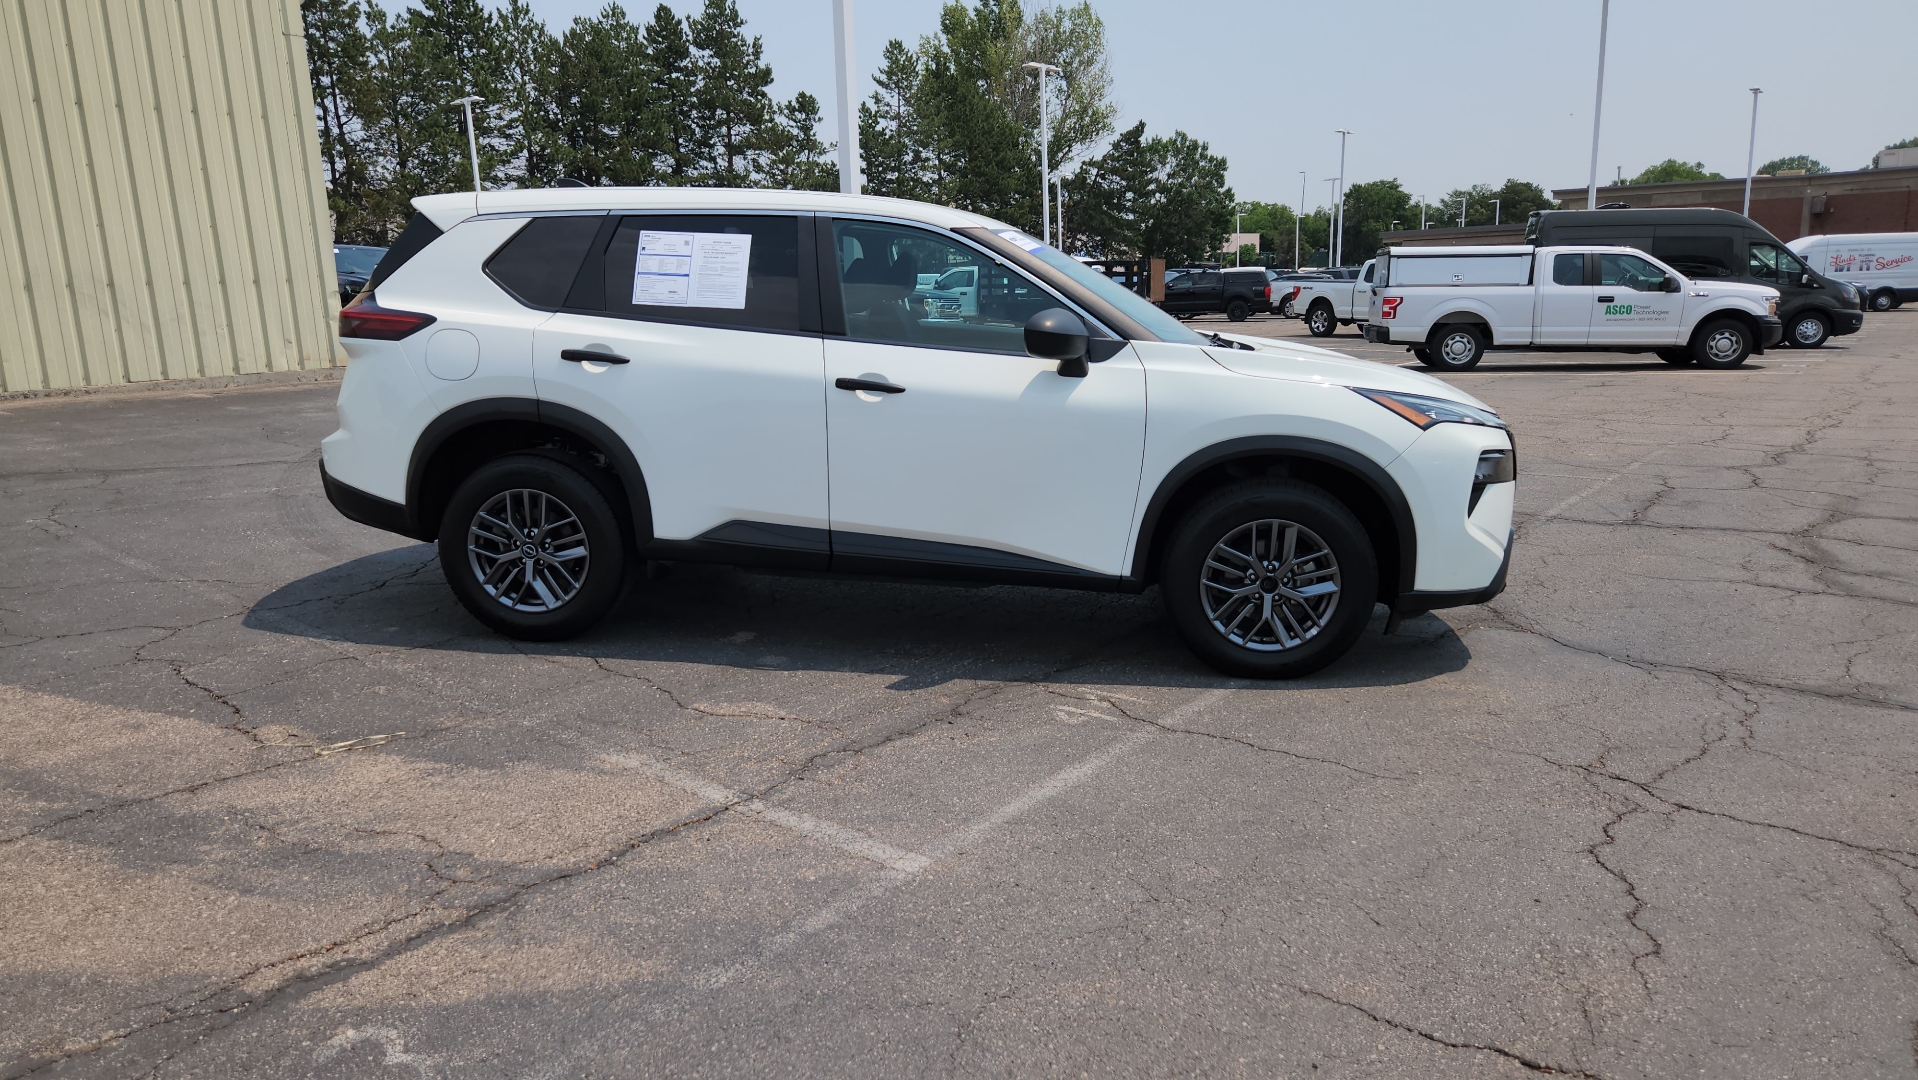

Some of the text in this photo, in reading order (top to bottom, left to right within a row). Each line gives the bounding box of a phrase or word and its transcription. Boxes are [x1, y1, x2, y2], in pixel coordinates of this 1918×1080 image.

[1830, 254, 1856, 266] Lind's
[1875, 255, 1914, 270] Service
[1605, 304, 1633, 315] ASCO
